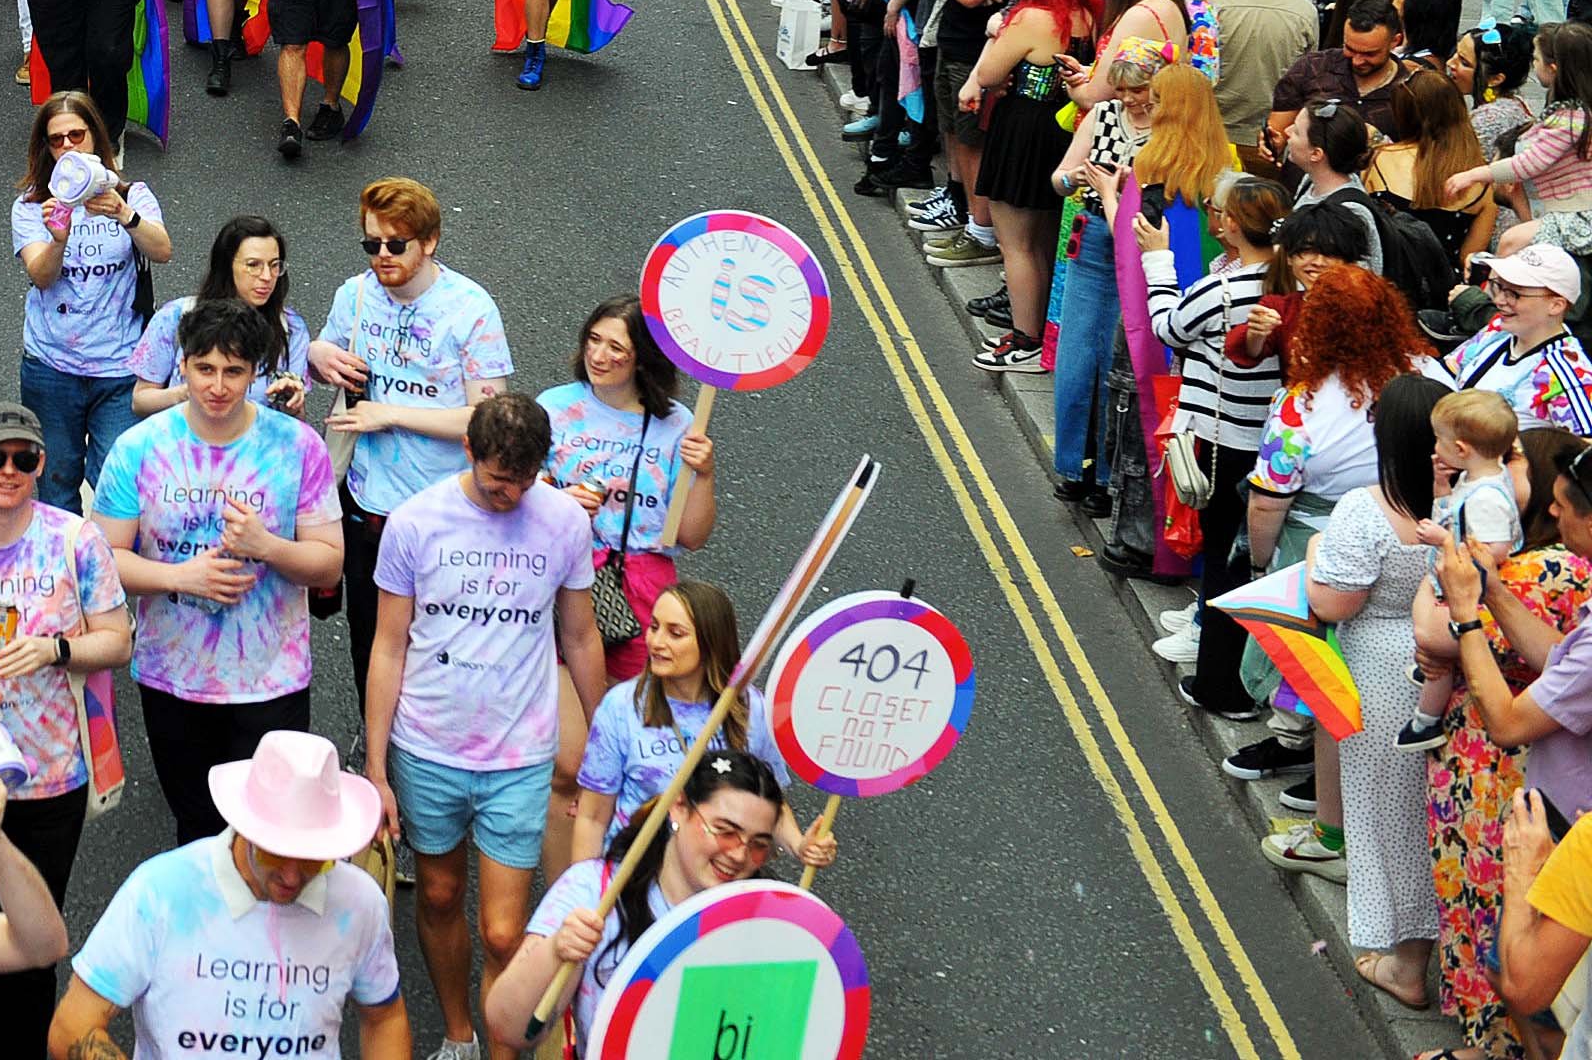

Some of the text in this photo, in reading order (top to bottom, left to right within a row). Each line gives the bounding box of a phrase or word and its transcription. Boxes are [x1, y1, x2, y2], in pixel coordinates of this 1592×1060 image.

[73, 219, 120, 238] rning
[78, 242, 104, 257] for
[61, 260, 126, 282] eryone
[662, 231, 813, 323] AUTHENTICITY
[361, 318, 432, 358] earning
[663, 307, 807, 373] BEAUTIFUL
[384, 347, 411, 369] for
[372, 373, 439, 398] ryone
[576, 455, 595, 474] is
[163, 483, 265, 514] Learning
[182, 511, 224, 533] is fo
[439, 547, 547, 577] Learning
[461, 574, 521, 596] is for
[425, 602, 542, 627] everyone
[839, 641, 932, 690] 404
[817, 685, 933, 723] CLOSET
[815, 734, 910, 773] FOUND
[195, 953, 330, 995] Learning
[224, 990, 301, 1021] is for
[177, 1029, 327, 1060] everyone
[713, 1009, 754, 1060] bi
